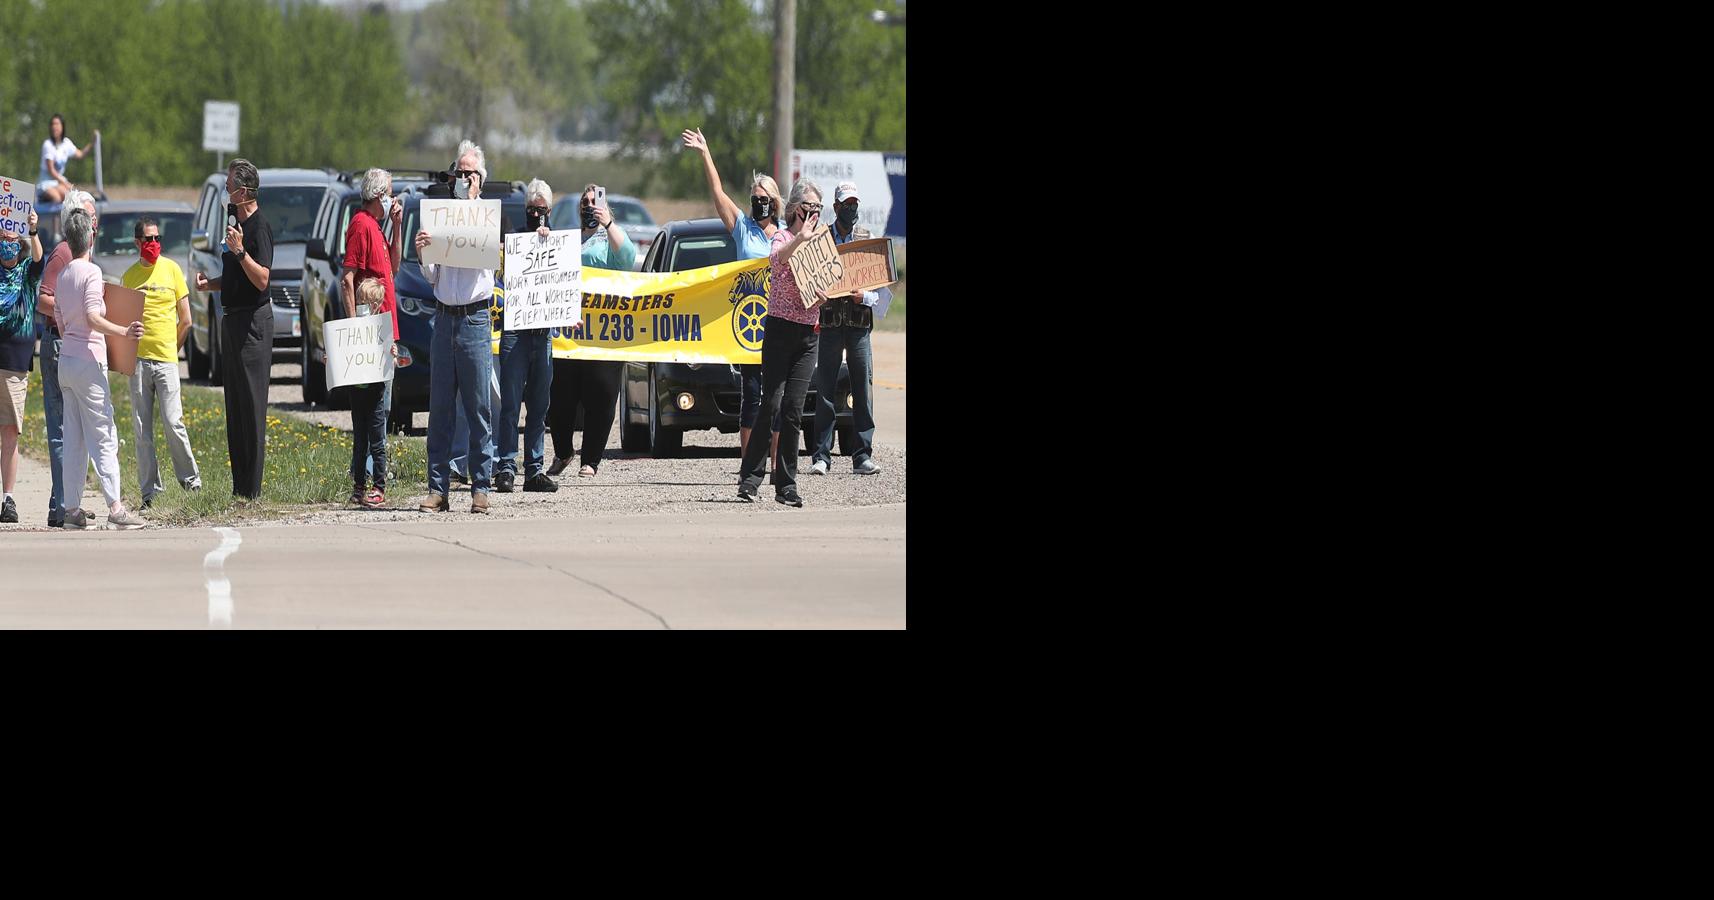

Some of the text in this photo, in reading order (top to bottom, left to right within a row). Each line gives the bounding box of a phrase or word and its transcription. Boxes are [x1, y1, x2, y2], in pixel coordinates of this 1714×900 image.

[430, 206, 497, 228] THANK
[506, 235, 522, 256] WE
[789, 230, 834, 286] PROTECT
[506, 276, 528, 291] WORK
[800, 256, 844, 306] WORKERS
[506, 293, 522, 312] FOR
[526, 291, 541, 306] ALL
[513, 305, 572, 328] EVERYWHERE
[599, 313, 634, 342] 238
[652, 313, 703, 342] IOWA
[335, 325, 385, 348] THANK
